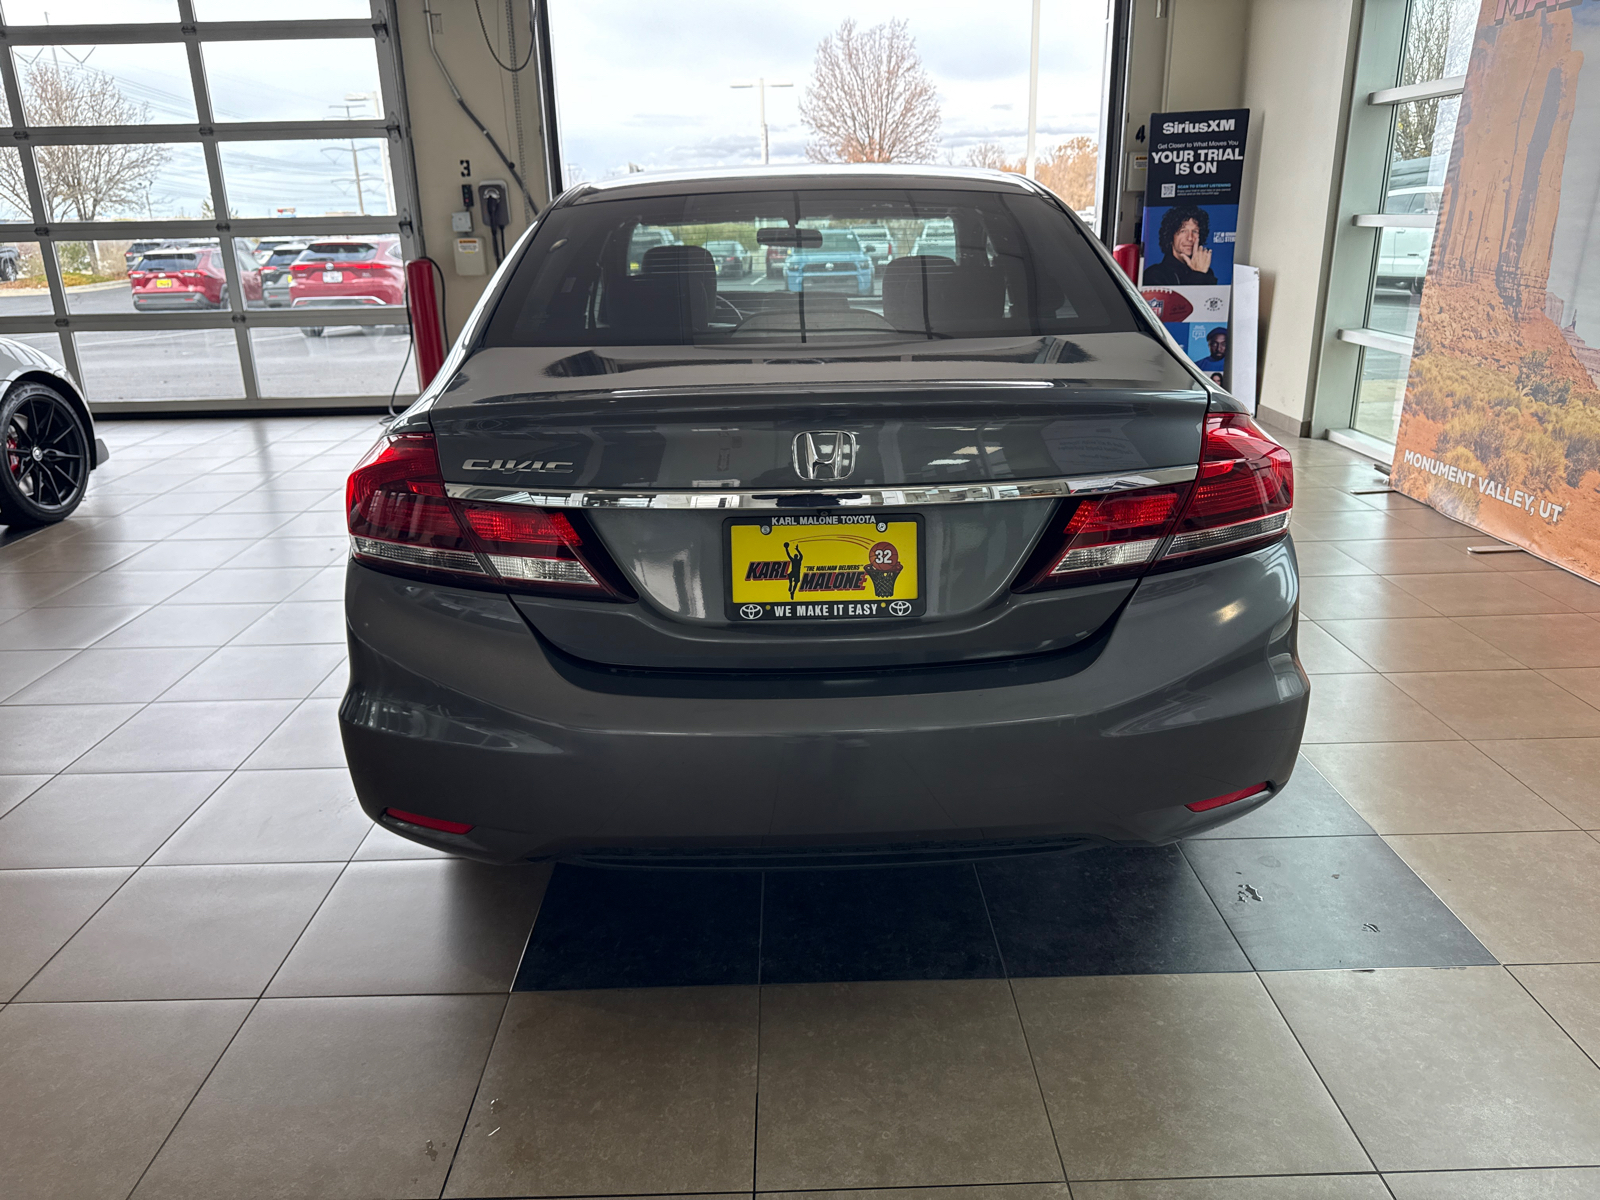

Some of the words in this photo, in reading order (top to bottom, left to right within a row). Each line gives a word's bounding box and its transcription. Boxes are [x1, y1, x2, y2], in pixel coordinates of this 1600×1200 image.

[1135, 125, 1146, 143] 4
[1162, 119, 1236, 135] SiriusXM
[1151, 150, 1195, 164] YOUR
[1197, 148, 1244, 162] TRIAL
[460, 160, 471, 177] 3
[1175, 162, 1191, 175] IS
[1193, 161, 1218, 174] ON
[462, 459, 574, 474] CIVIC
[1403, 449, 1476, 489] MONUMENT
[1478, 477, 1536, 516] VALLEY,
[1539, 500, 1563, 523] UT
[771, 516, 797, 526] KARL
[799, 515, 839, 525] MALONE
[841, 515, 877, 524] TOYOTA
[874, 549, 893, 564] 32
[745, 561, 791, 581] KARL
[798, 571, 867, 592] MALONE
[774, 606, 792, 617] WE
[796, 604, 830, 616] MAKE
[833, 604, 844, 615] IT
[848, 603, 878, 615] EASY
